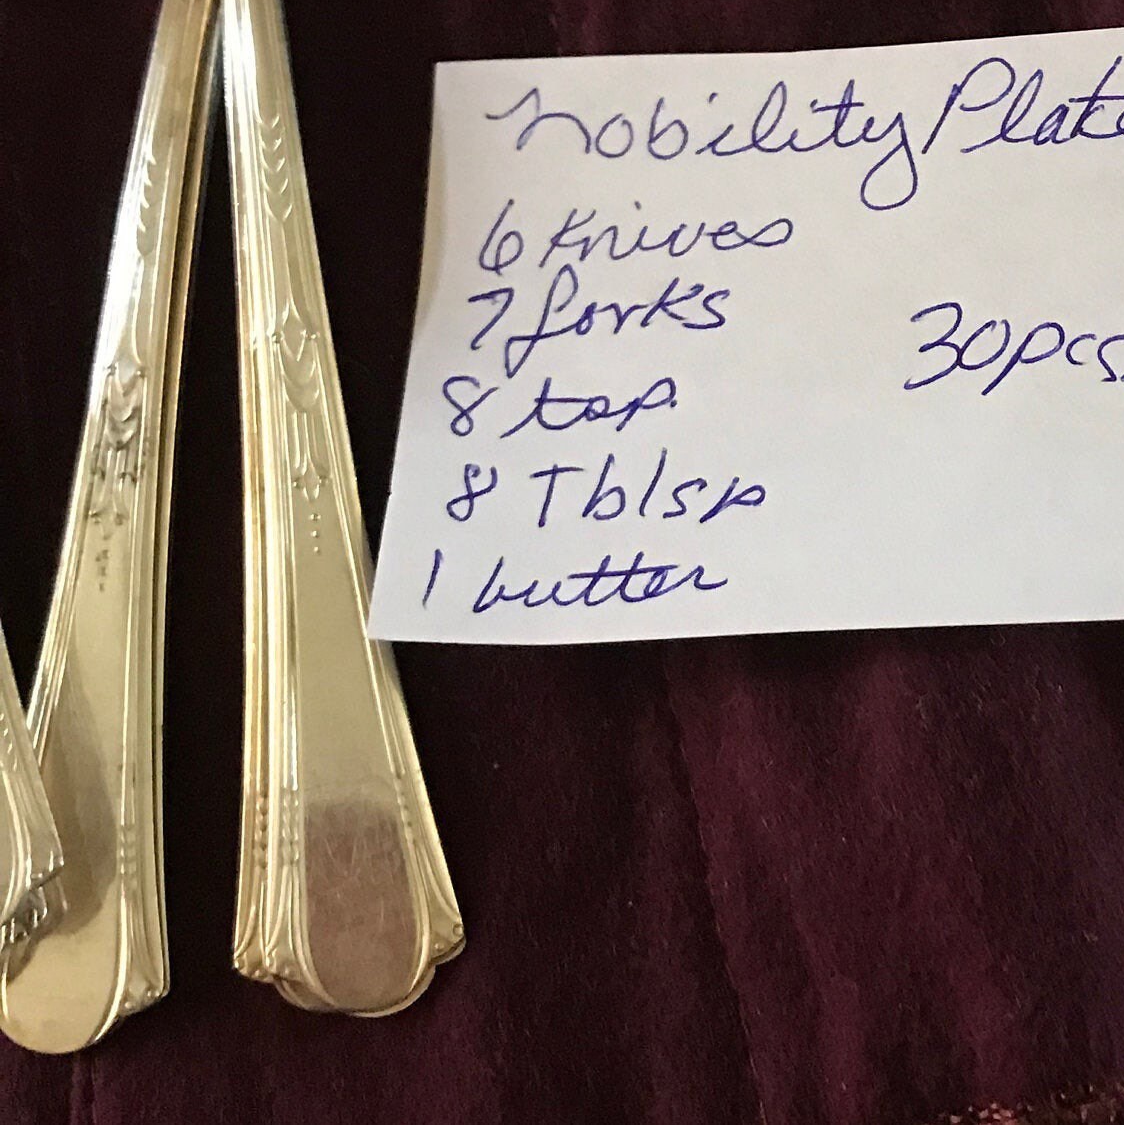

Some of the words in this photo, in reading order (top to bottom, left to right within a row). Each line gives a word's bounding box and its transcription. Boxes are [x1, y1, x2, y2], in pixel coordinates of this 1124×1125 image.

[478, 198, 524, 275] 6
[467, 286, 514, 351] 7
[442, 375, 499, 437] 8
[446, 463, 498, 522] 8
[422, 548, 443, 610] 1
[472, 550, 729, 614] butter
